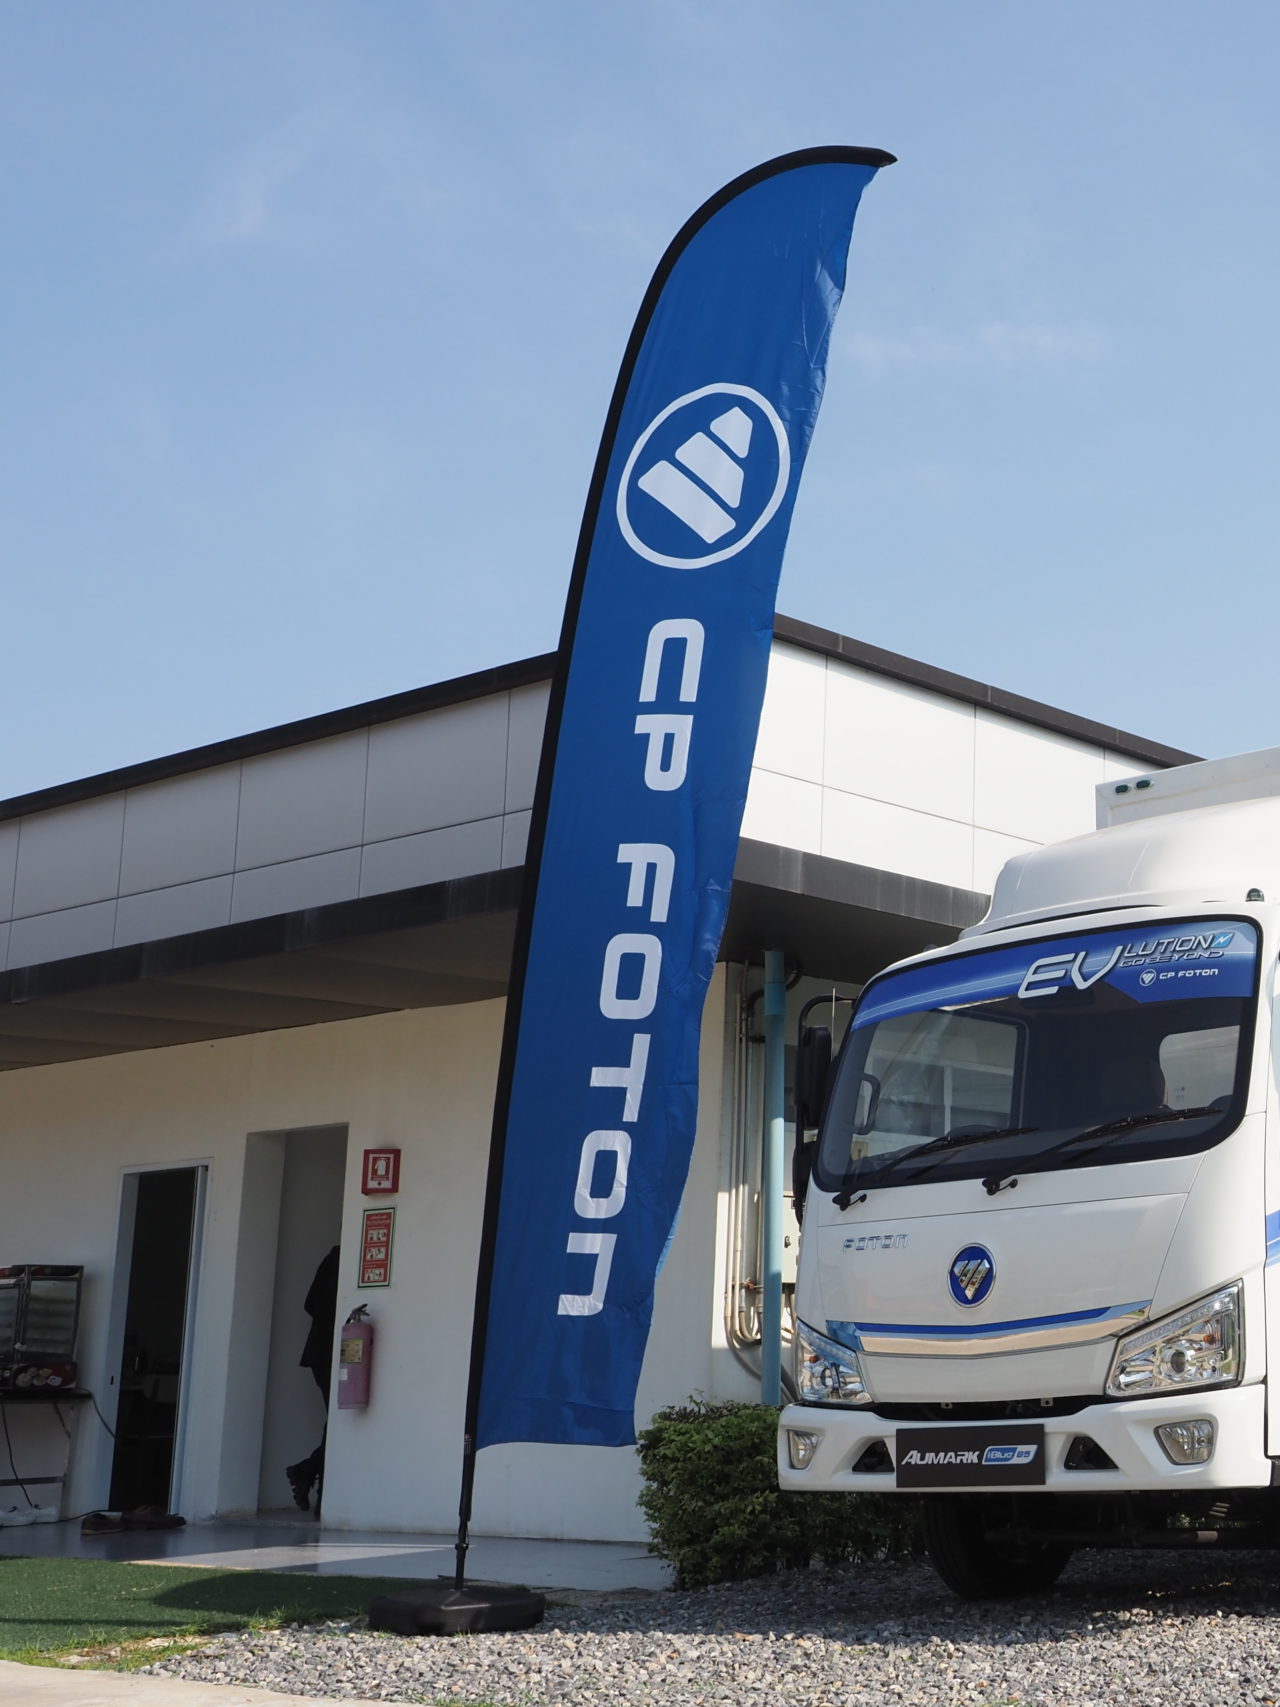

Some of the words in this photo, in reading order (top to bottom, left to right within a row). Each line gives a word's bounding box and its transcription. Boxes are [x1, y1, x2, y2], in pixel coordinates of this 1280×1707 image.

[634, 618, 705, 792] CP
[1159, 972, 1176, 980] CP
[1178, 968, 1219, 978] FOTON
[556, 842, 676, 1318] FOTON
[842, 1234, 909, 1252] FOTON
[901, 1449, 980, 1465] AUMARK
